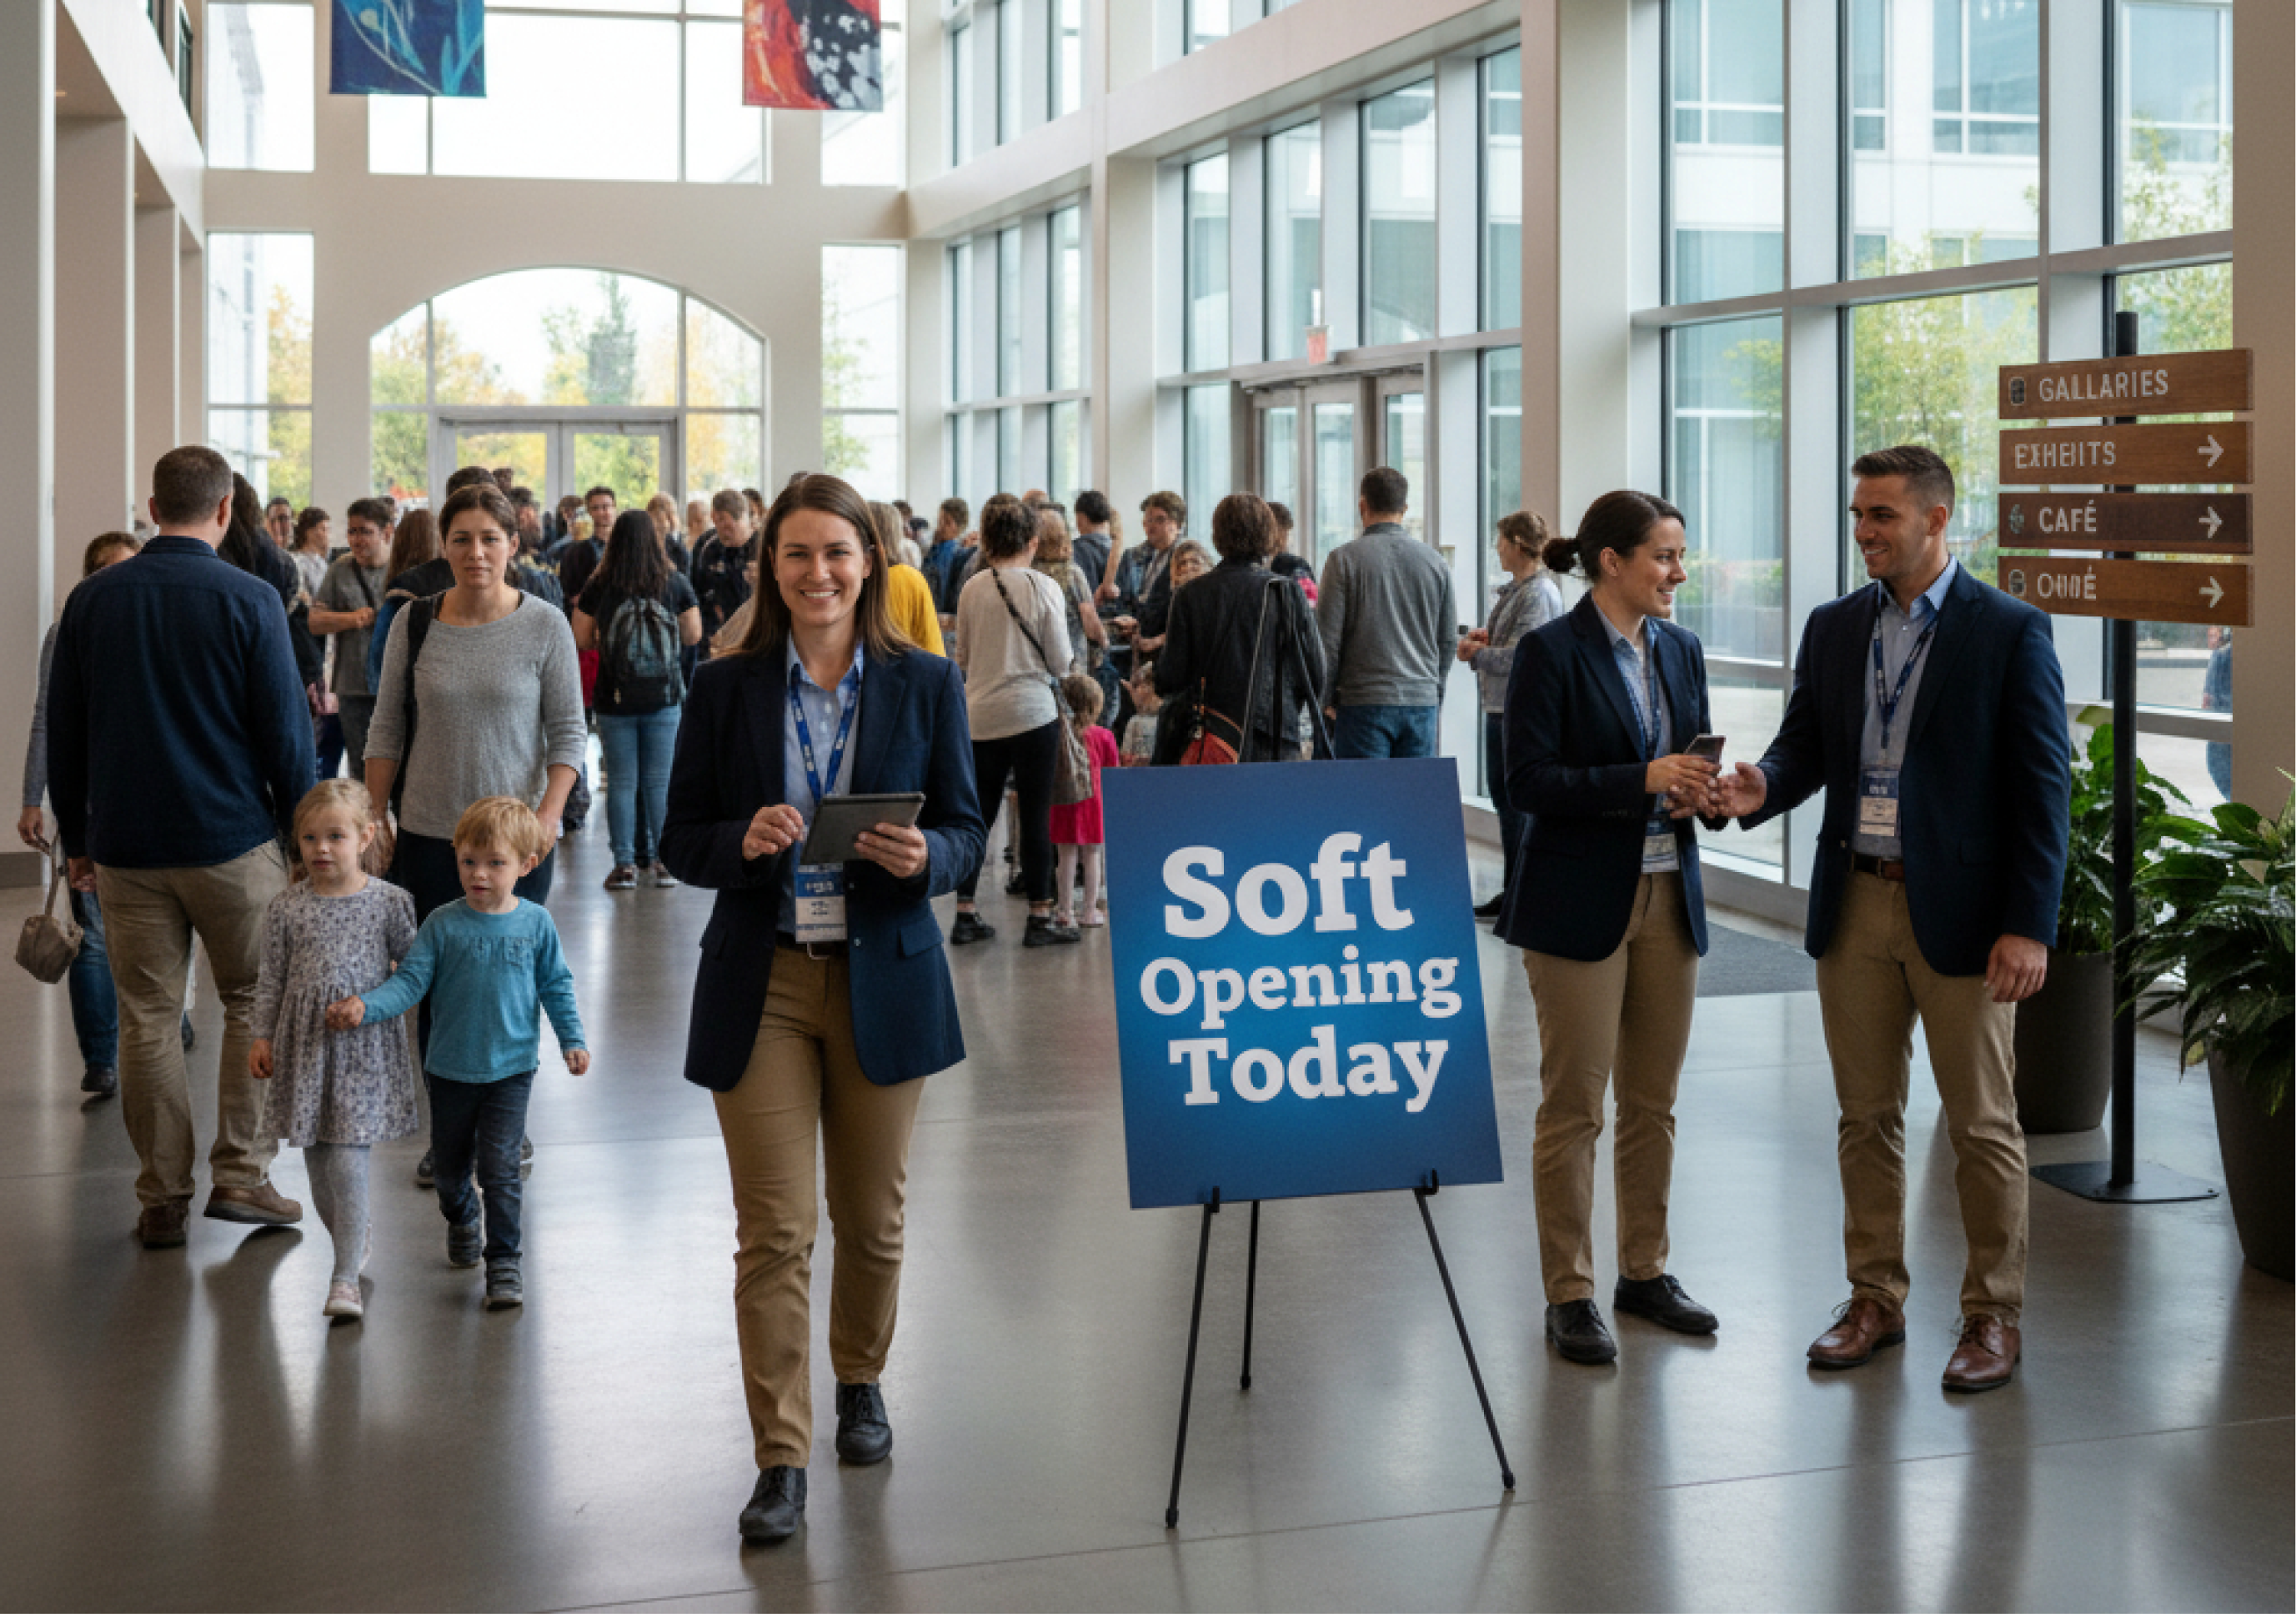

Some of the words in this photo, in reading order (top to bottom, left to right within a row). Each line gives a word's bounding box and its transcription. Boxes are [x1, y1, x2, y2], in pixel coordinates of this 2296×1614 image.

[2038, 369, 2168, 402] GALLARIES
[2039, 499, 2097, 533] CAFÉ
[1162, 831, 1415, 939] Soft
[1140, 943, 1462, 1030] Opening
[1167, 1024, 1449, 1113] Today
